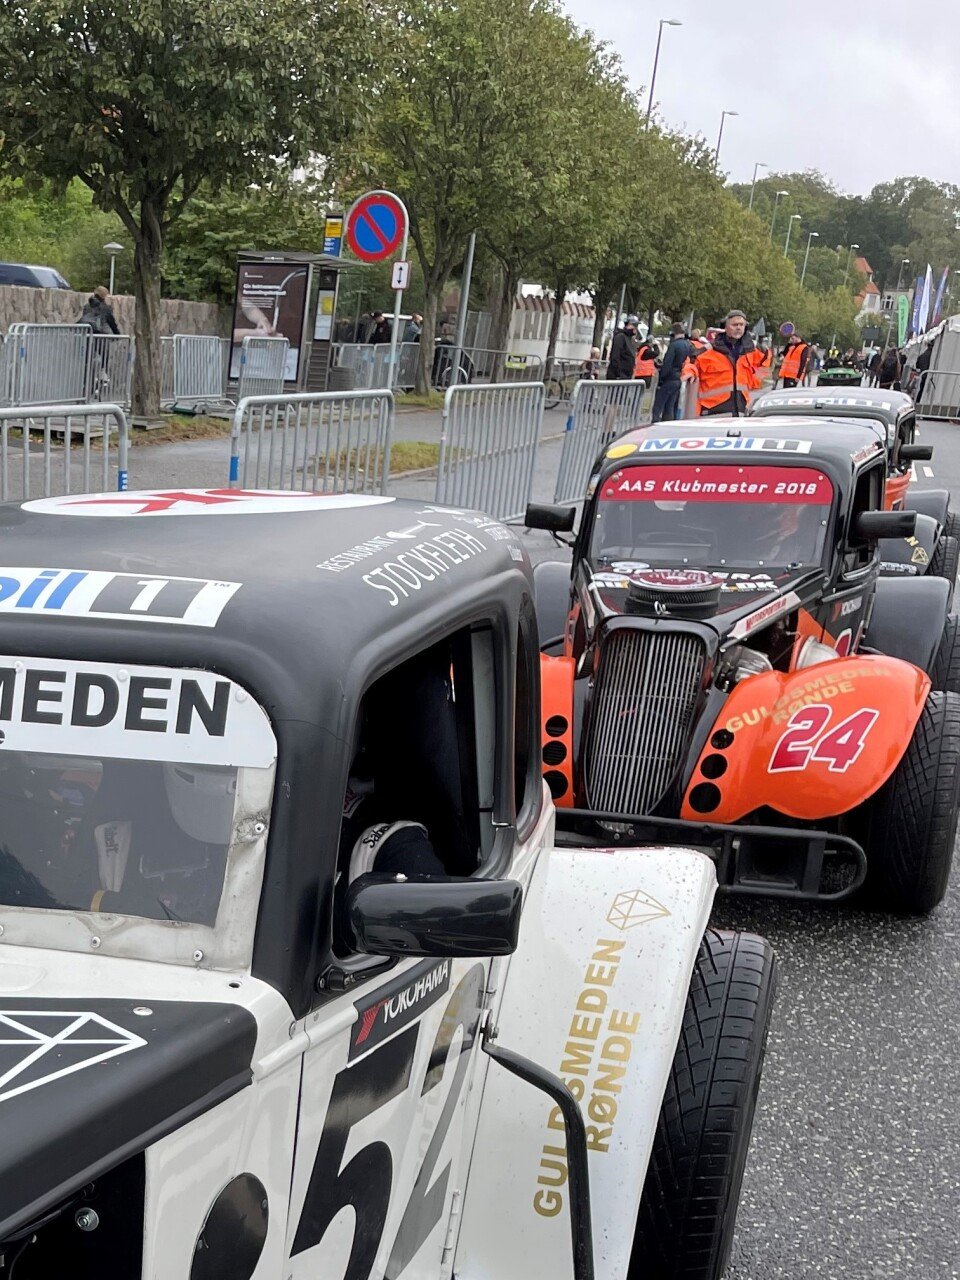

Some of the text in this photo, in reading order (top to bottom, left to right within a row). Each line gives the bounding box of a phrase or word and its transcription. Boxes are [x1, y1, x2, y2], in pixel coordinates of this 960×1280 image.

[644, 437, 754, 450] Mobil
[619, 480, 817, 495] AAS Klubmester 2018
[316, 535, 399, 573] RESTAURANT
[362, 528, 487, 606] STOCKFLETH
[129, 579, 170, 611] 1
[767, 704, 879, 774] 24
[384, 960, 448, 1023] YOKOHAMA
[533, 937, 625, 1218] GULDSMEDEN
[586, 1009, 642, 1154] RØNDE
